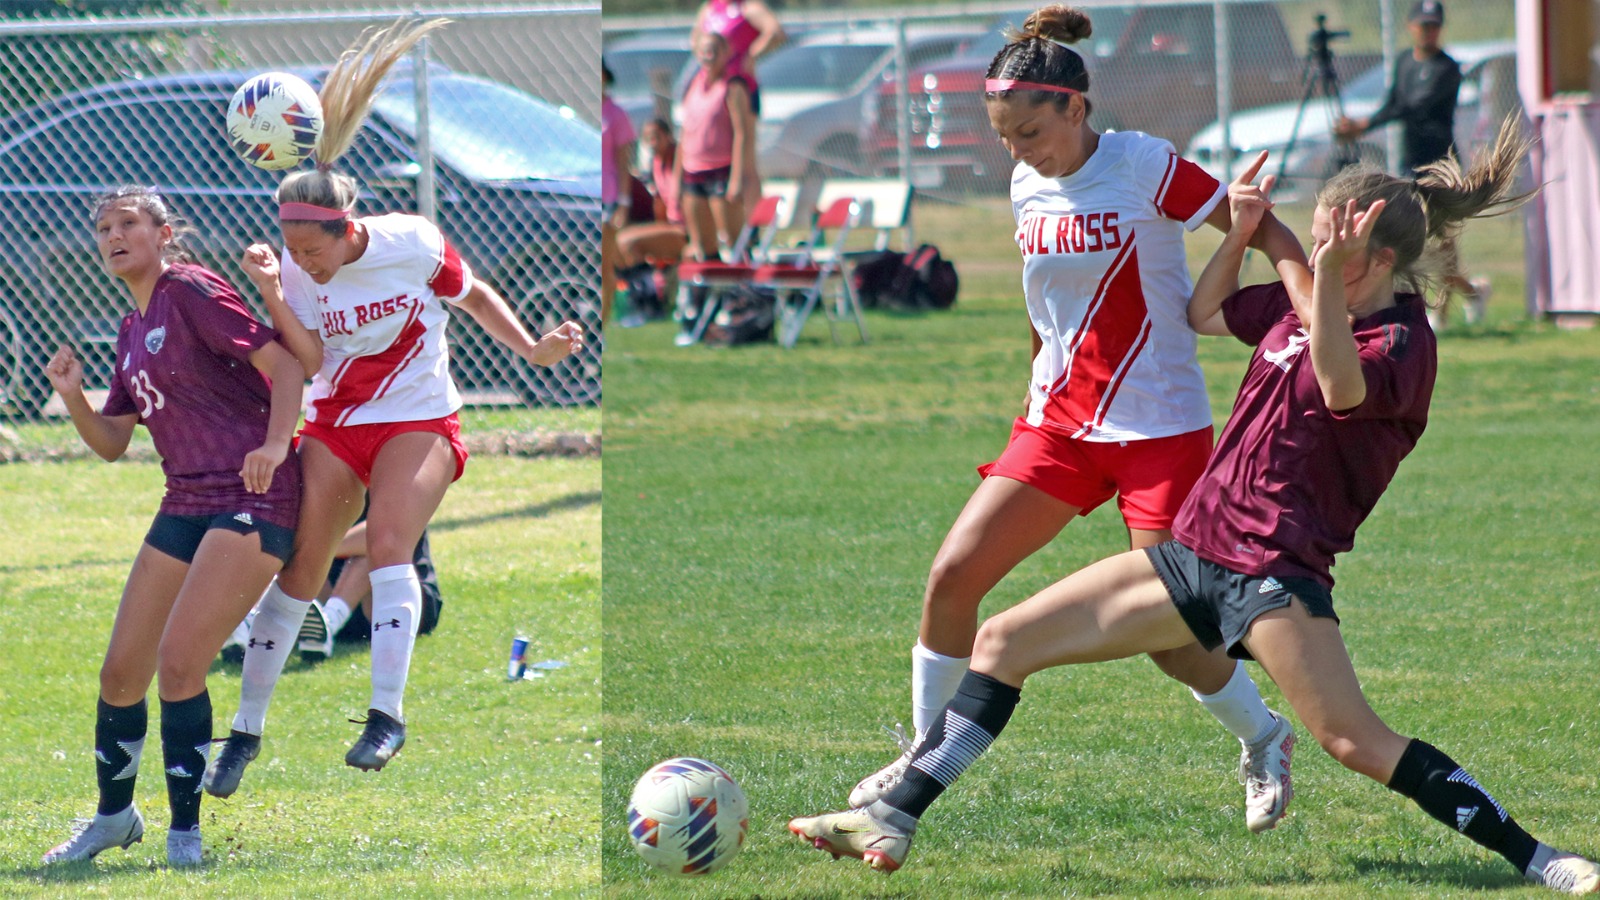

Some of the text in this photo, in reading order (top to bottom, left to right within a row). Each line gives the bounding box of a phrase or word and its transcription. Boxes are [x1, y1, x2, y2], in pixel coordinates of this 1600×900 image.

[1056, 212, 1121, 254] ROSS
[353, 294, 408, 327] ROSS
[131, 369, 164, 419] 33
